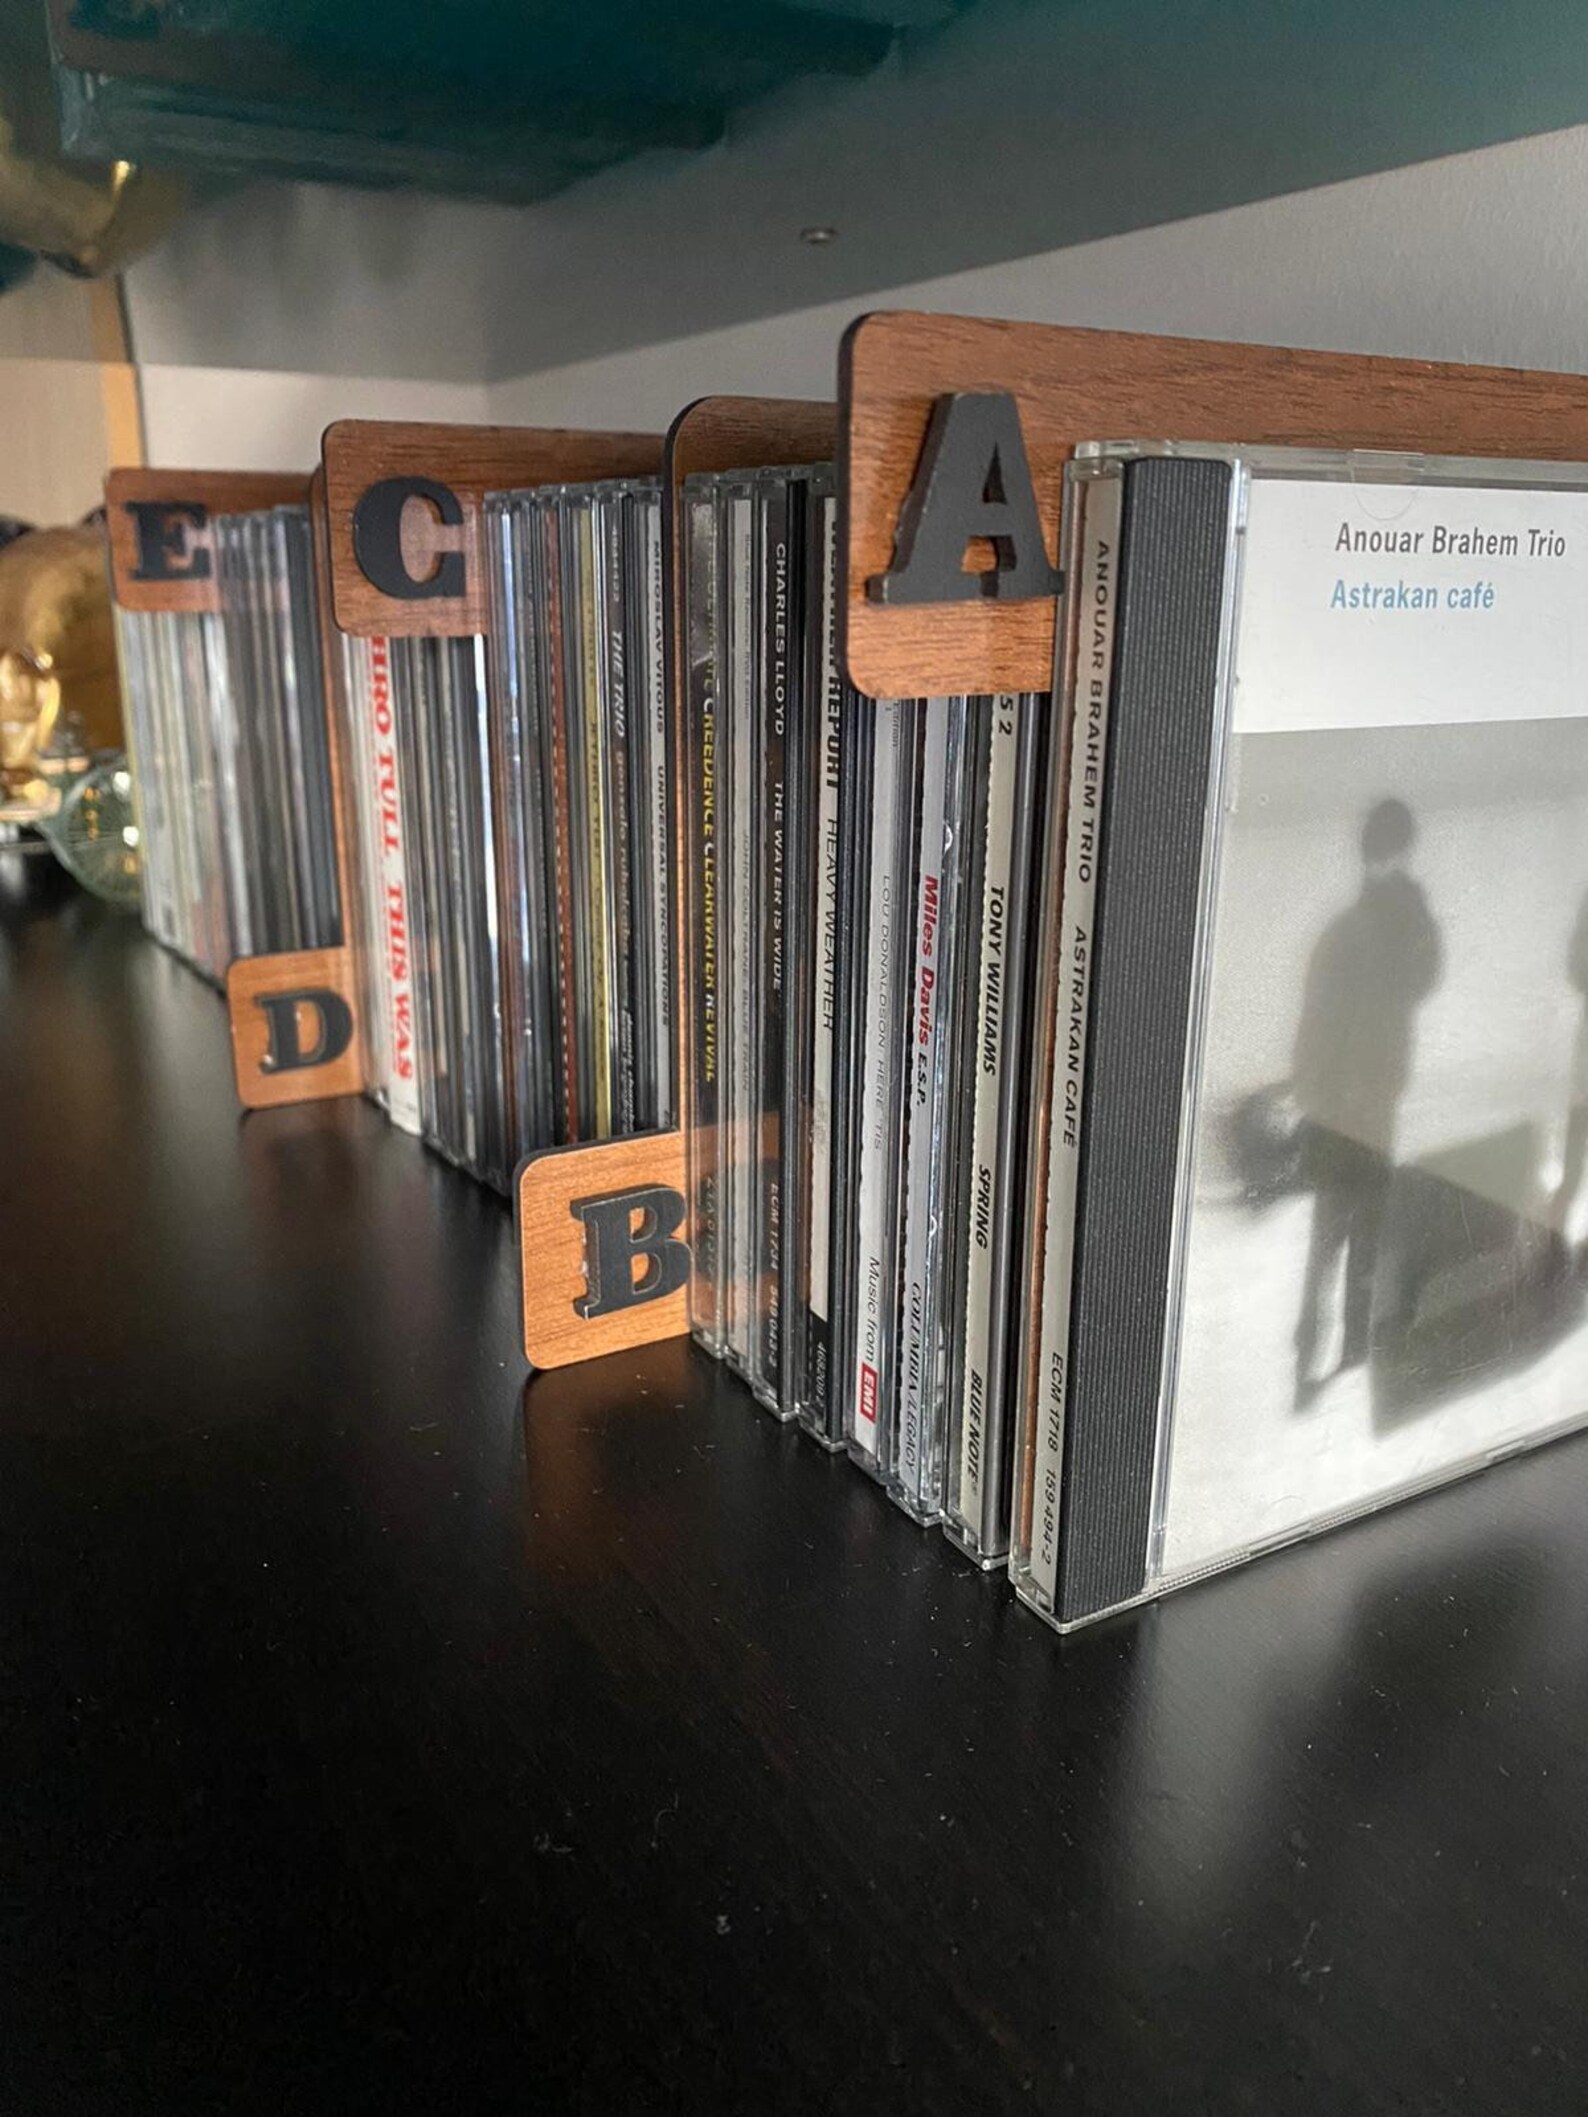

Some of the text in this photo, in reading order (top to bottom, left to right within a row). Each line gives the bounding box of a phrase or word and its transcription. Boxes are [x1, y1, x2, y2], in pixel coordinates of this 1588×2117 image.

[355, 476, 467, 601] C
[866, 391, 1067, 604] A
[1335, 522, 1566, 557] Anouar Brahem Trio
[125, 501, 213, 582] E
[774, 542, 787, 654] CHARLES
[1331, 579, 1494, 609] Astrakan café
[612, 630, 626, 738] THE TRIO
[774, 661, 786, 736] LLOYD
[703, 697, 716, 837] CREEDENCE
[826, 676, 842, 789] REPORT
[999, 719, 1014, 736] 2
[653, 540, 669, 1027] MIROSLAV VITOUS UNIVERSAL SYNCOPATIONS
[774, 781, 784, 823] THE
[371, 636, 412, 1080] HRO TULL THIS WAS
[773, 829, 784, 908] WATER
[824, 818, 838, 904] HEAVY
[881, 875, 891, 919] LOU
[704, 842, 715, 990] CLEARWATER
[773, 909, 784, 931] IS
[988, 886, 1005, 956] TONY
[772, 938, 783, 992] WIDE
[822, 906, 836, 1030] WEATHER
[877, 924, 890, 1049] DONALDSON
[916, 875, 938, 1107] Miles Davis E.S.P.
[257, 989, 354, 1075] D
[705, 993, 716, 1083] REVIVAL
[983, 961, 1001, 1076] WILLIAMS
[1041, 540, 1111, 1565] ANOUAR BRAHEM TRIO ASTRAKAN CAFÉ ECM 1718 159 494-2
[875, 1059, 886, 1108] HERE
[769, 1183, 781, 1223] ECM
[976, 1165, 992, 1250] SPRING
[570, 1184, 692, 1320] B
[864, 1256, 880, 1362] Music from
[861, 1369, 876, 1415] EMI
[968, 1369, 983, 1424] BLUE
